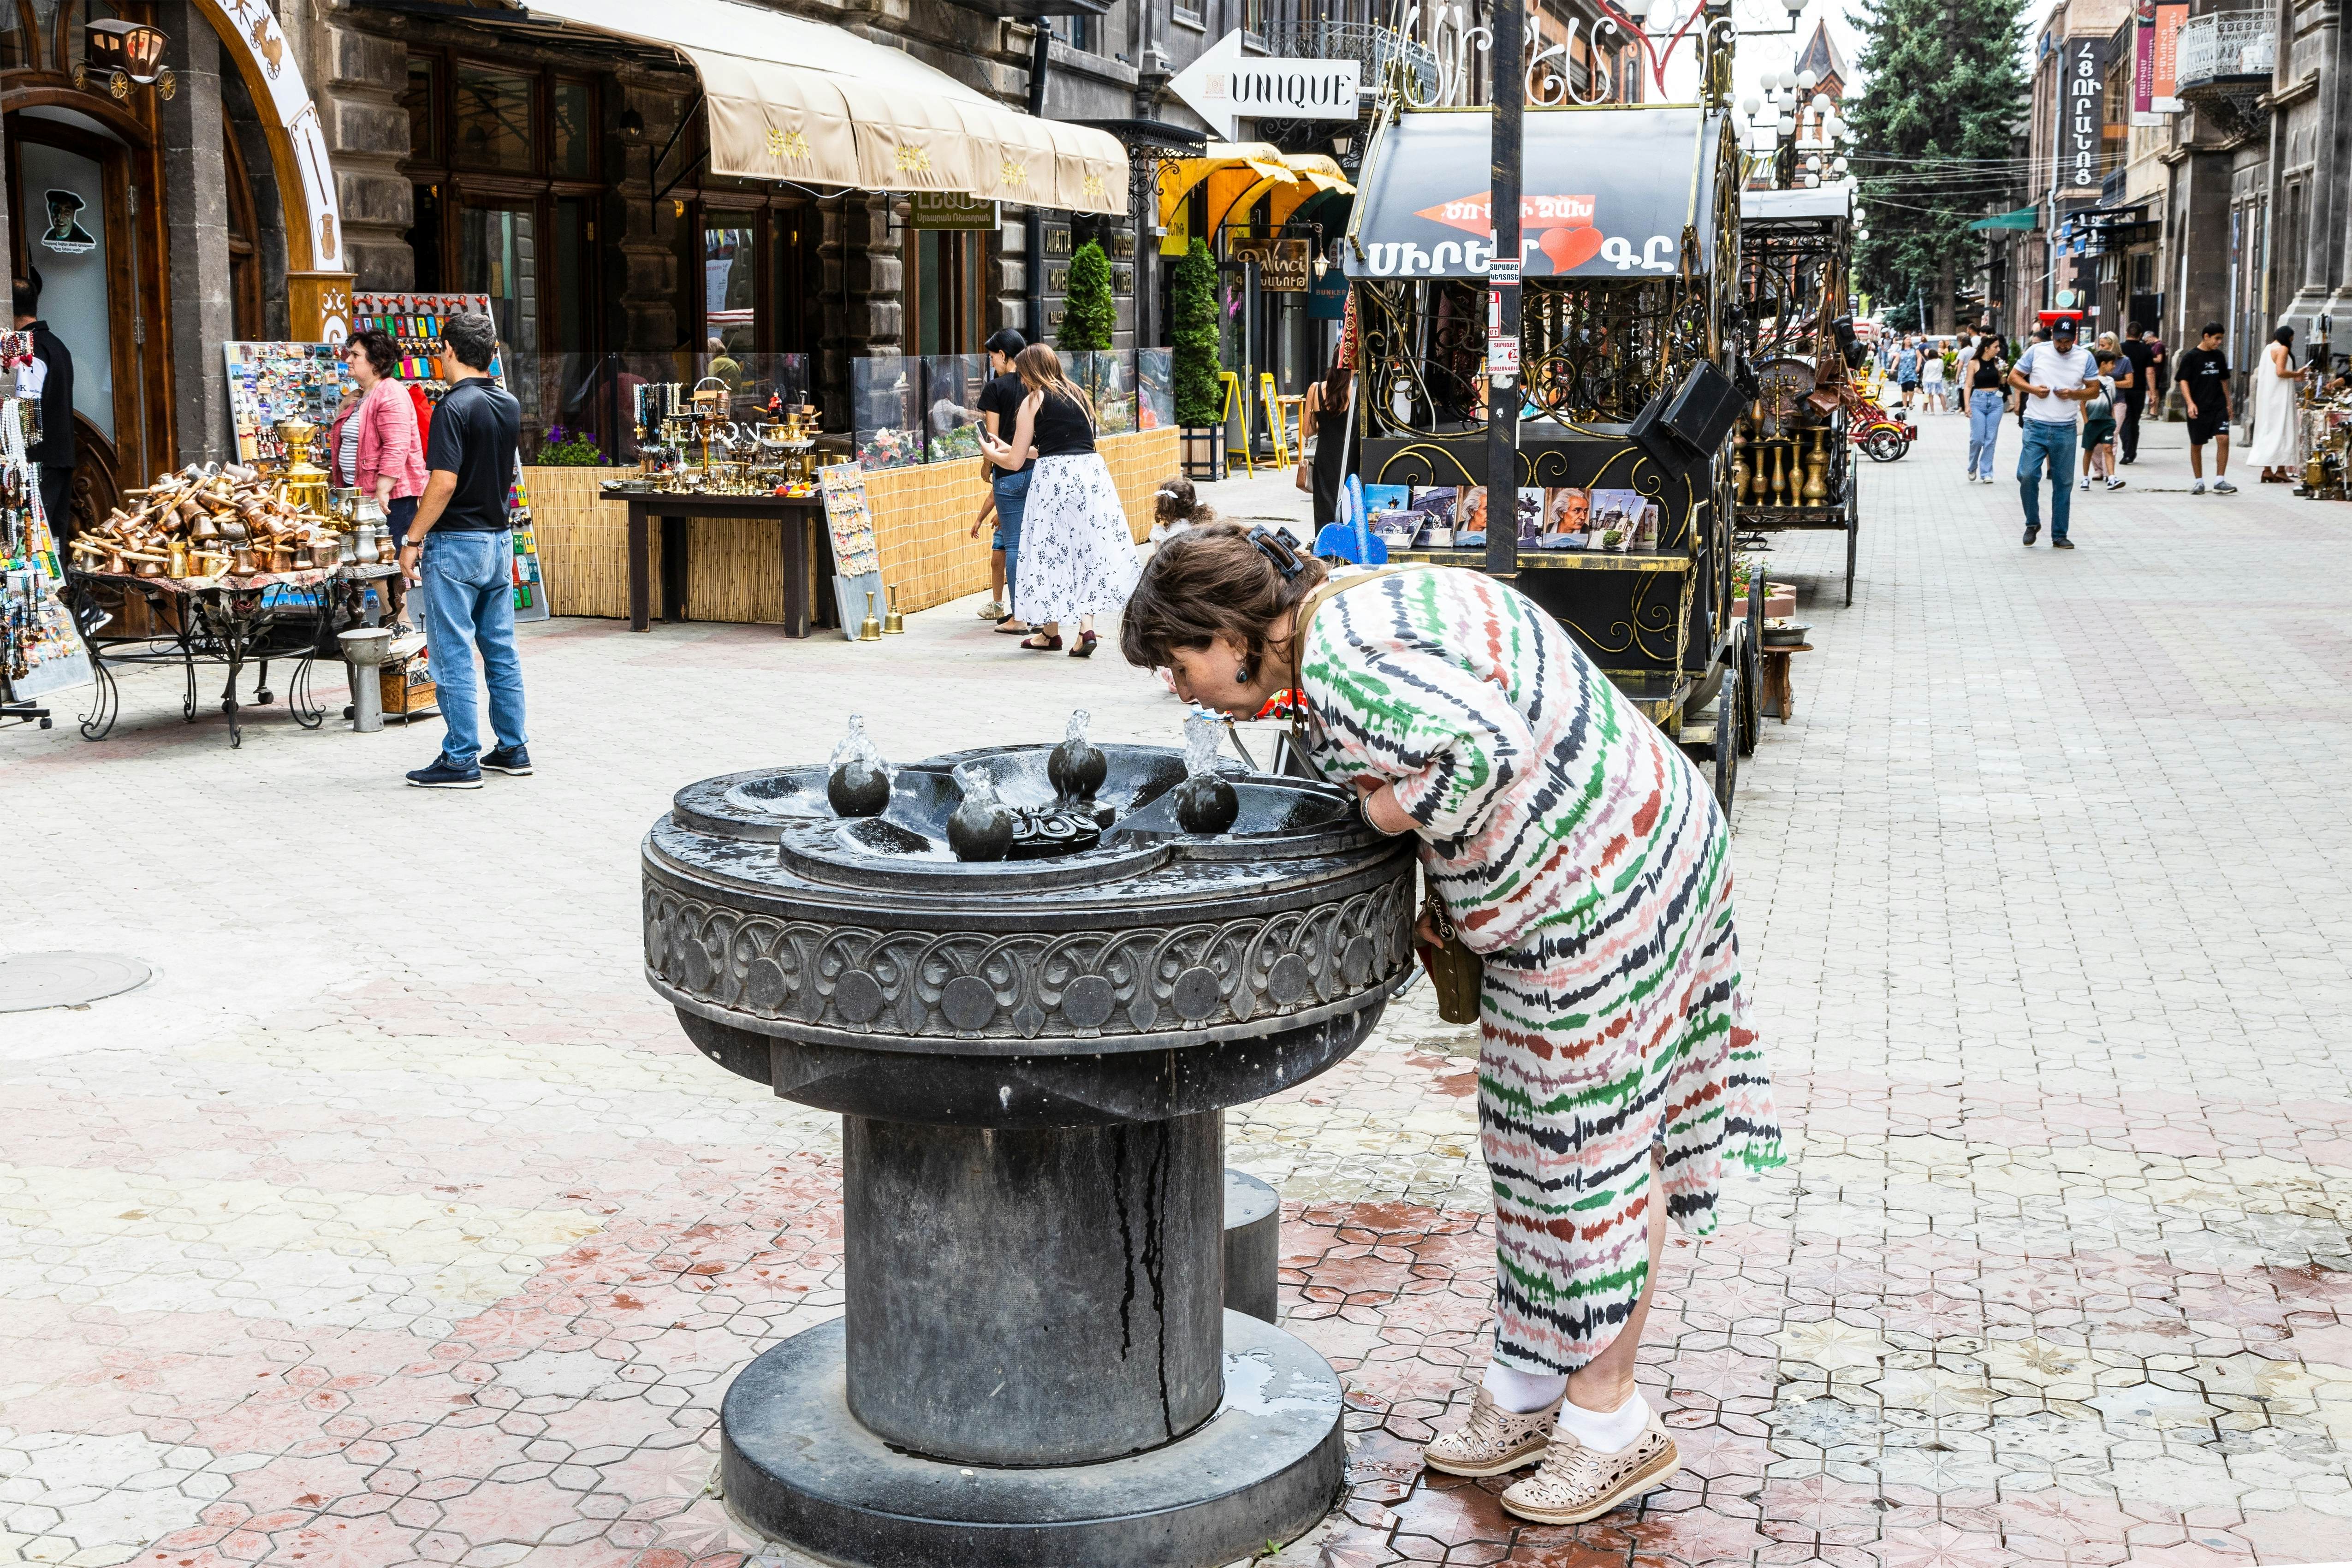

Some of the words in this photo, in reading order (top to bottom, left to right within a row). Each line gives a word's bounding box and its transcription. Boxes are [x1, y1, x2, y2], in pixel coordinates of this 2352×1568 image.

[1232, 72, 1352, 109] UNIQUE
[2072, 42, 2102, 185] ՀՅՈՒՐԱՆՈՑ
[1046, 229, 1072, 253] ARATTA
[1600, 236, 1675, 273] ԳԸ
[1048, 268, 1068, 291] HOTE
